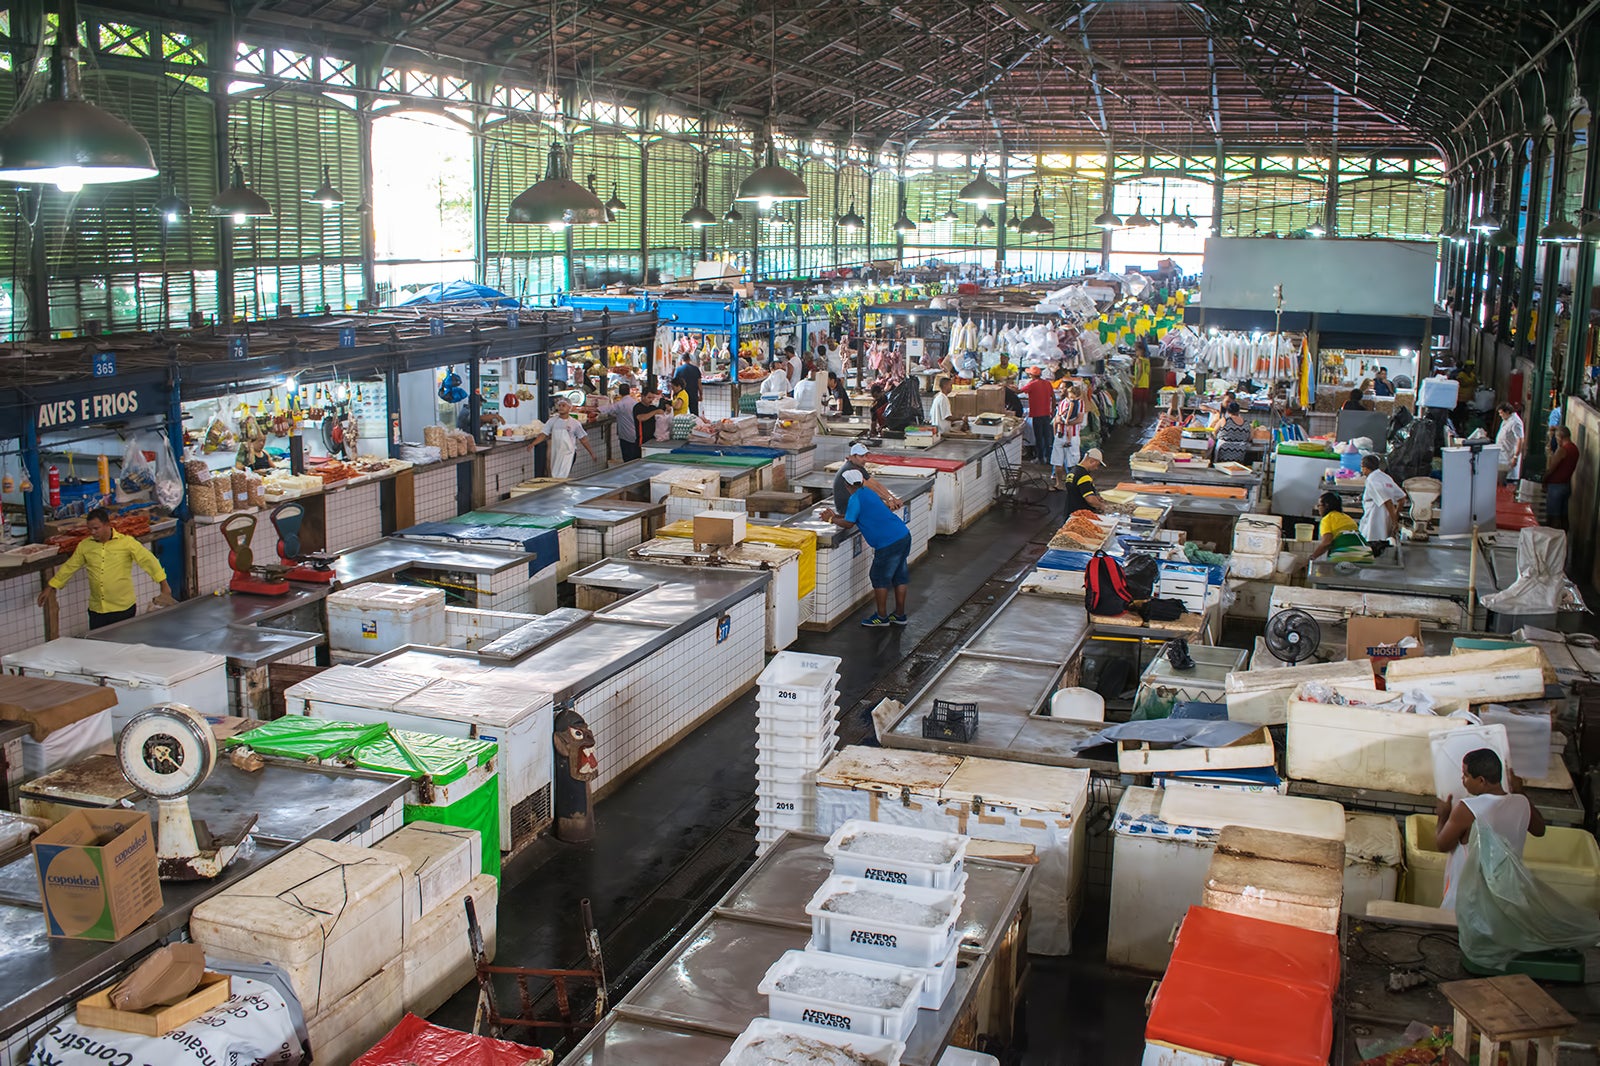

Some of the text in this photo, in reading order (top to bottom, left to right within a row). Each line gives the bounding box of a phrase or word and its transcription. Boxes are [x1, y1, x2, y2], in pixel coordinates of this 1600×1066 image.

[343, 335, 352, 346] 77
[233, 346, 244, 357] 76
[96, 362, 114, 375] 365
[38, 390, 138, 428] AVES E FRIOS
[1372, 647, 1401, 656] HOSHI
[778, 690, 797, 700] 2018
[776, 802, 795, 811] 2018
[114, 830, 149, 864] copoideal
[864, 874, 908, 885] PESCADOS
[865, 867, 908, 880] AZEVEDO
[47, 874, 100, 887] copoideal
[850, 930, 897, 943] AZEVEDO
[850, 936, 897, 948] PESCADOS
[802, 1015, 851, 1030] PESCADOS
[803, 1009, 851, 1025] AZEVEDO
